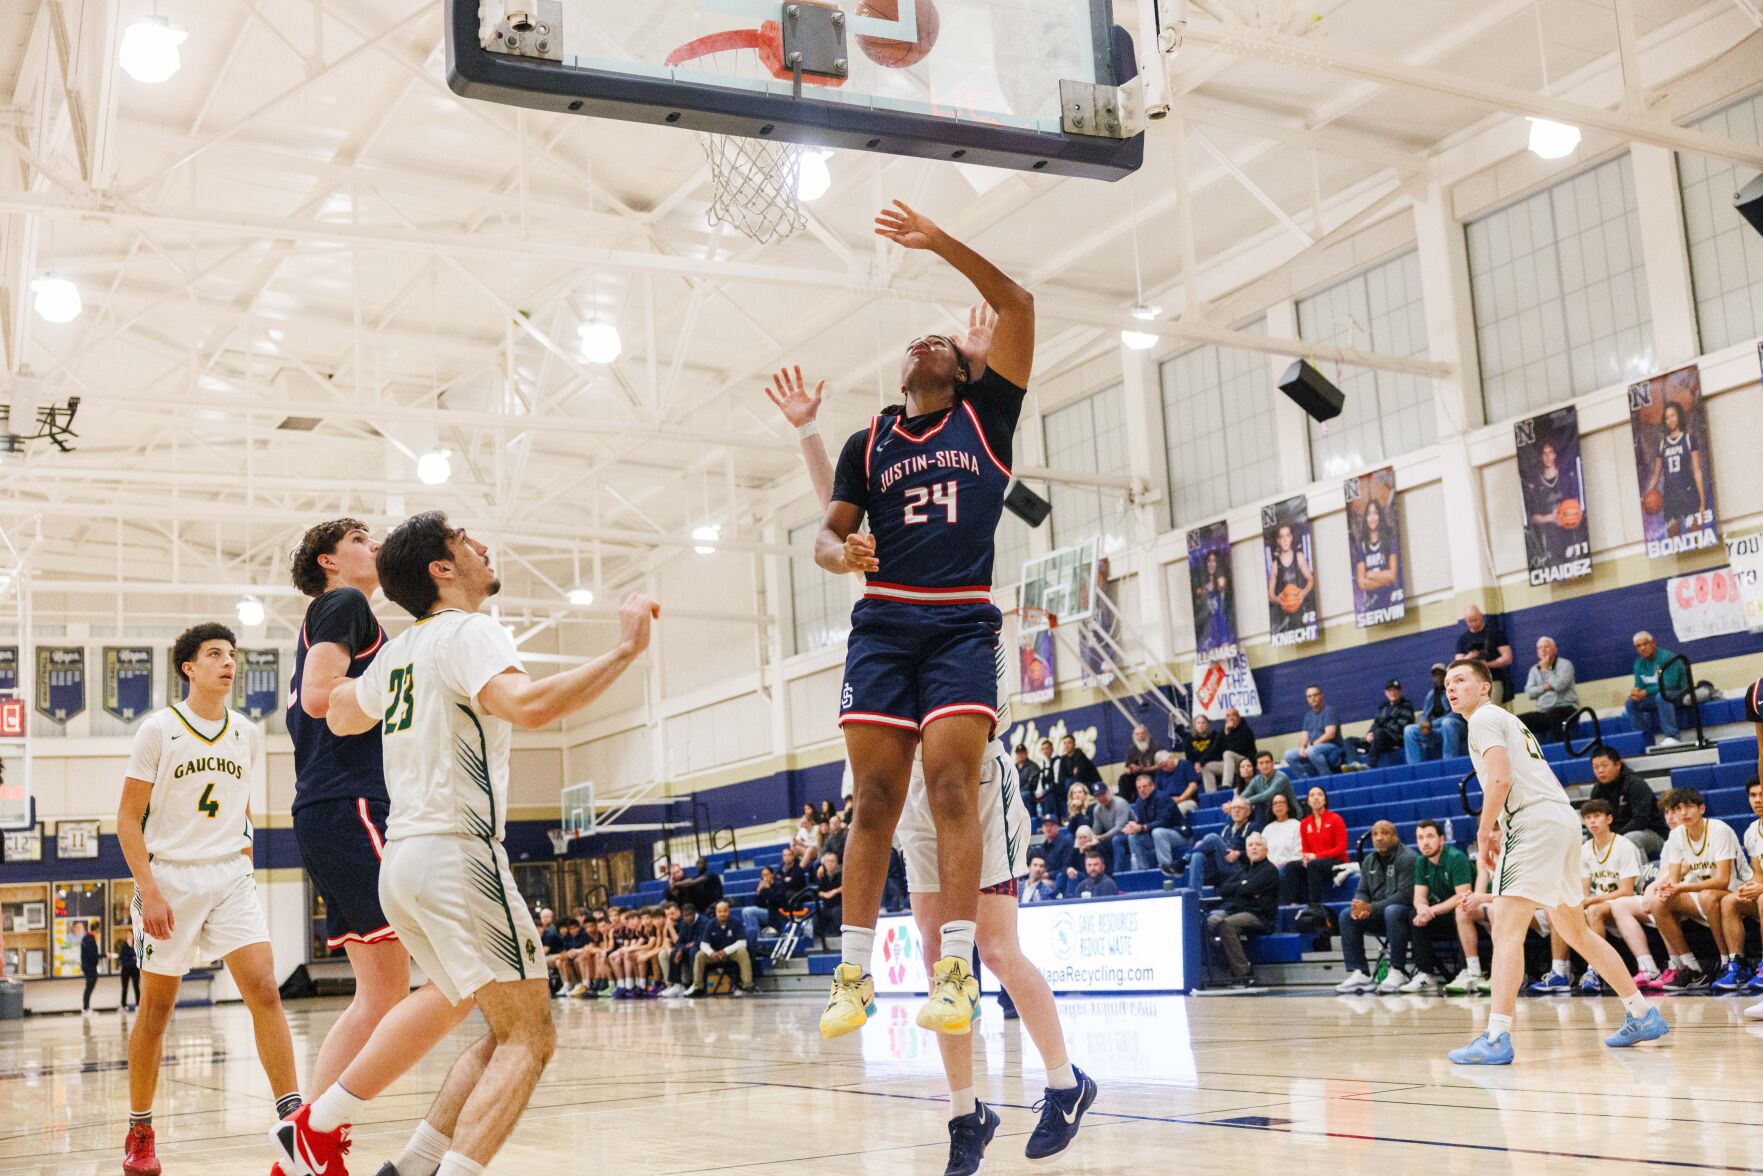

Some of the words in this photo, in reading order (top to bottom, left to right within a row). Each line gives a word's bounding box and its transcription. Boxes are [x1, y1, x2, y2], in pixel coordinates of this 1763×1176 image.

[1628, 381, 1653, 411] N
[1514, 419, 1536, 447] N
[880, 450, 980, 494] JUSTIN-SIENA
[903, 480, 958, 525] 24
[1685, 509, 1713, 528] #13
[1565, 541, 1589, 558] #11
[1530, 558, 1592, 586] CHAIDEZ
[384, 662, 414, 735] 23
[174, 756, 243, 780] GAUCHOS
[198, 782, 220, 819] 4
